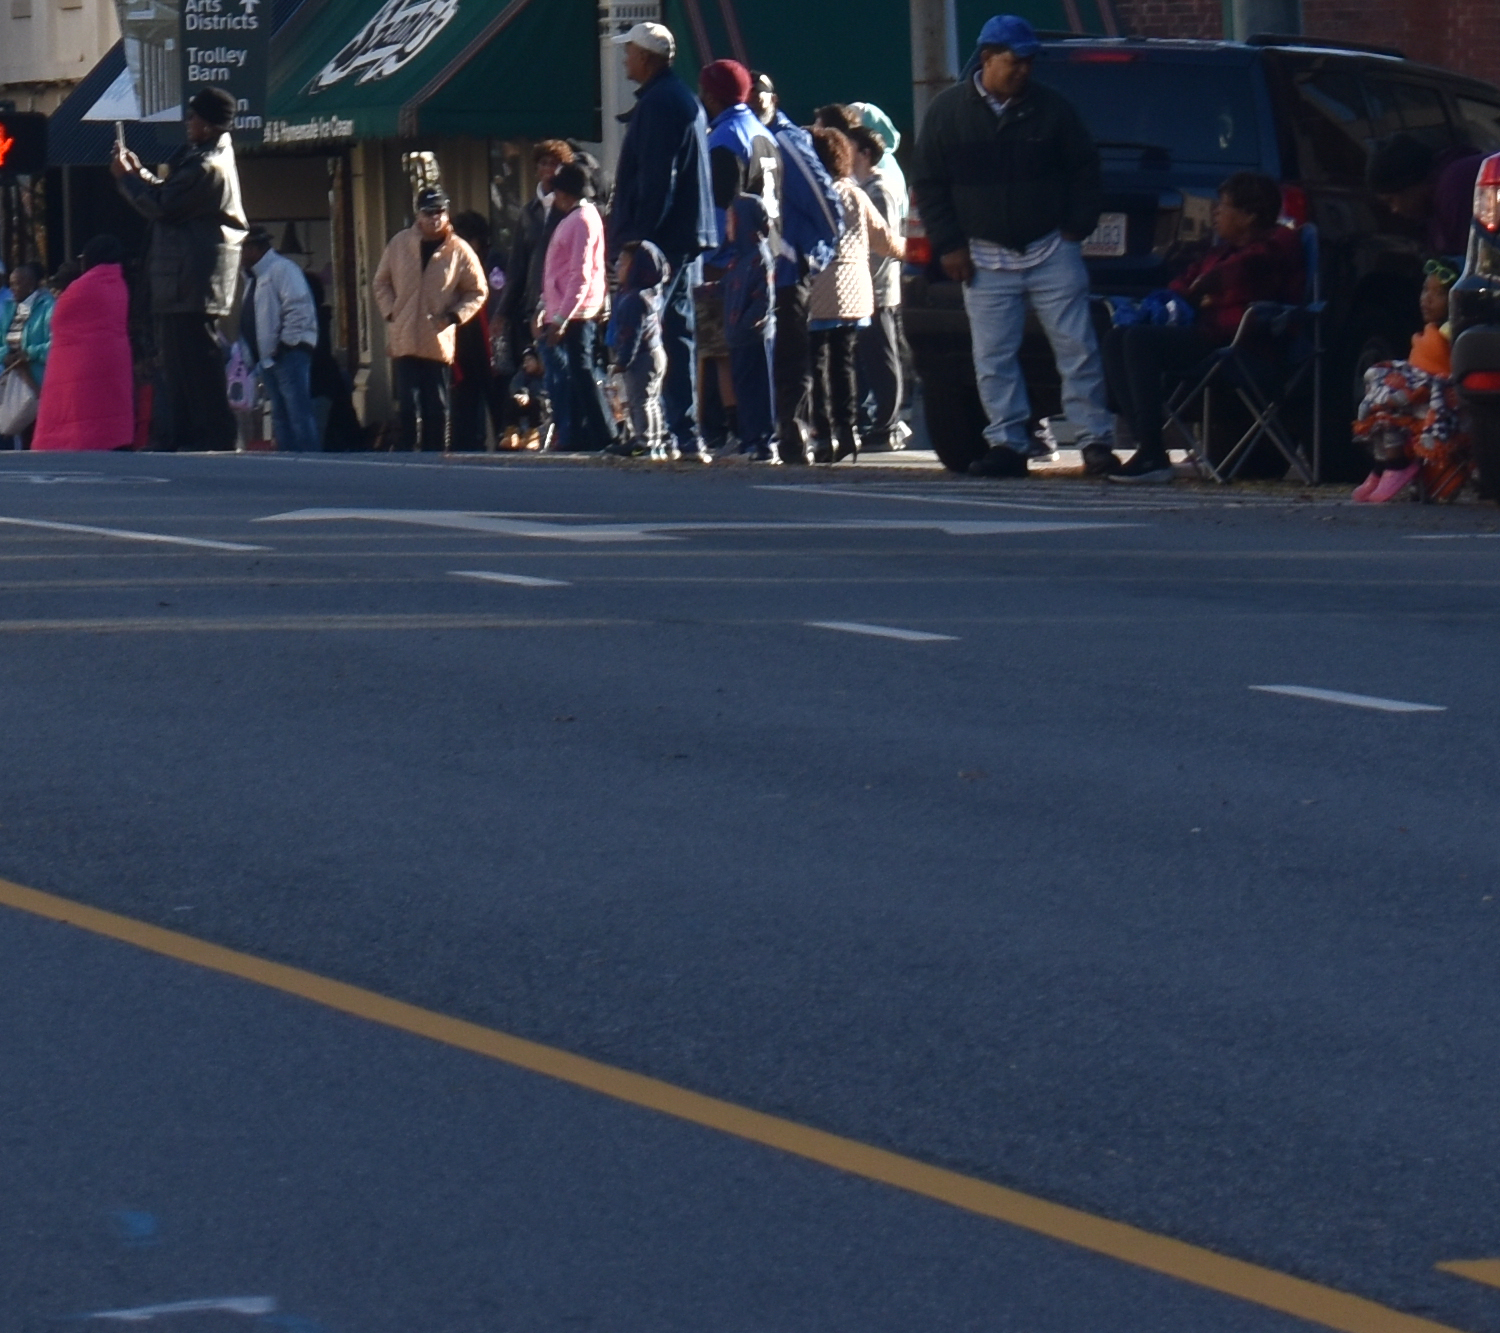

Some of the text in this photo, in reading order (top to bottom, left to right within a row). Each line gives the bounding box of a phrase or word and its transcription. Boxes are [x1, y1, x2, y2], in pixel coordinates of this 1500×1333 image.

[185, 13, 259, 31] Districts
[187, 47, 248, 67] Trolley
[188, 65, 230, 82] Barn
